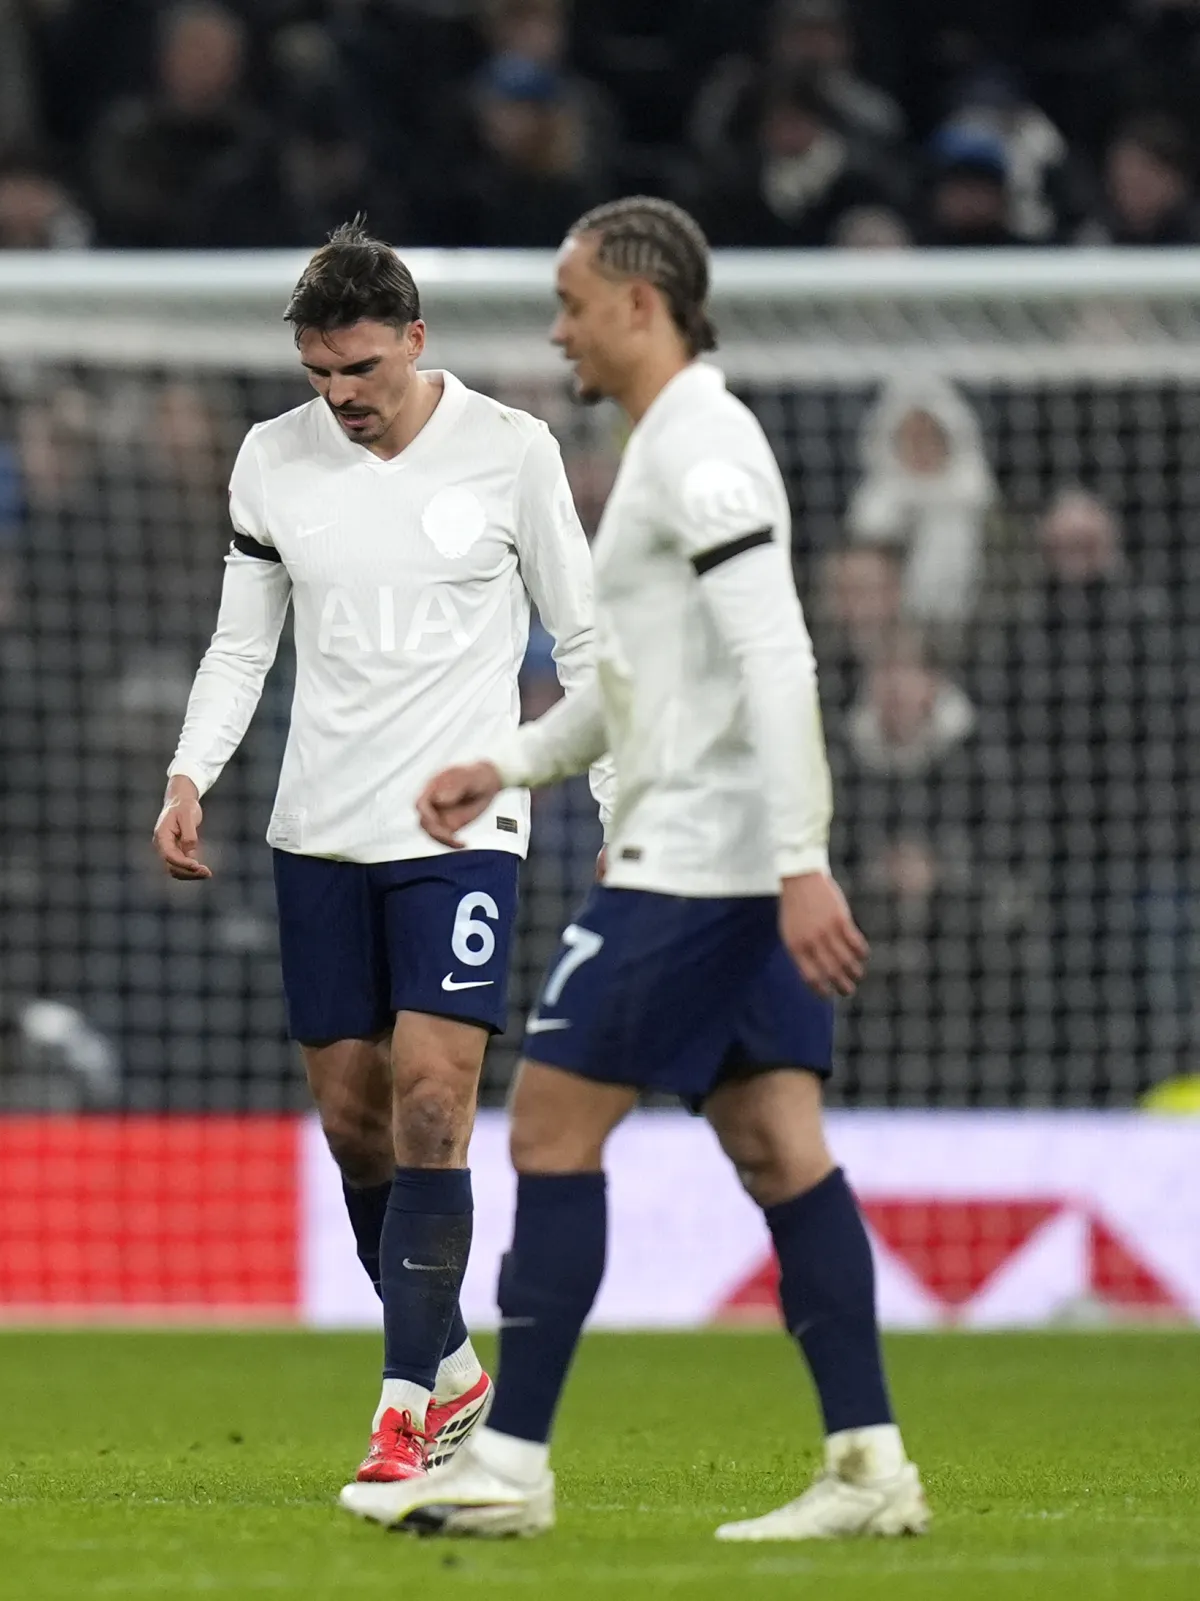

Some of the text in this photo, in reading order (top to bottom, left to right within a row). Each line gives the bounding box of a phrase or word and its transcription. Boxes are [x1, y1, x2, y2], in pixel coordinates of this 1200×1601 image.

[319, 587, 472, 654] AIA
[451, 891, 499, 966] 6
[544, 923, 604, 1007] 7
